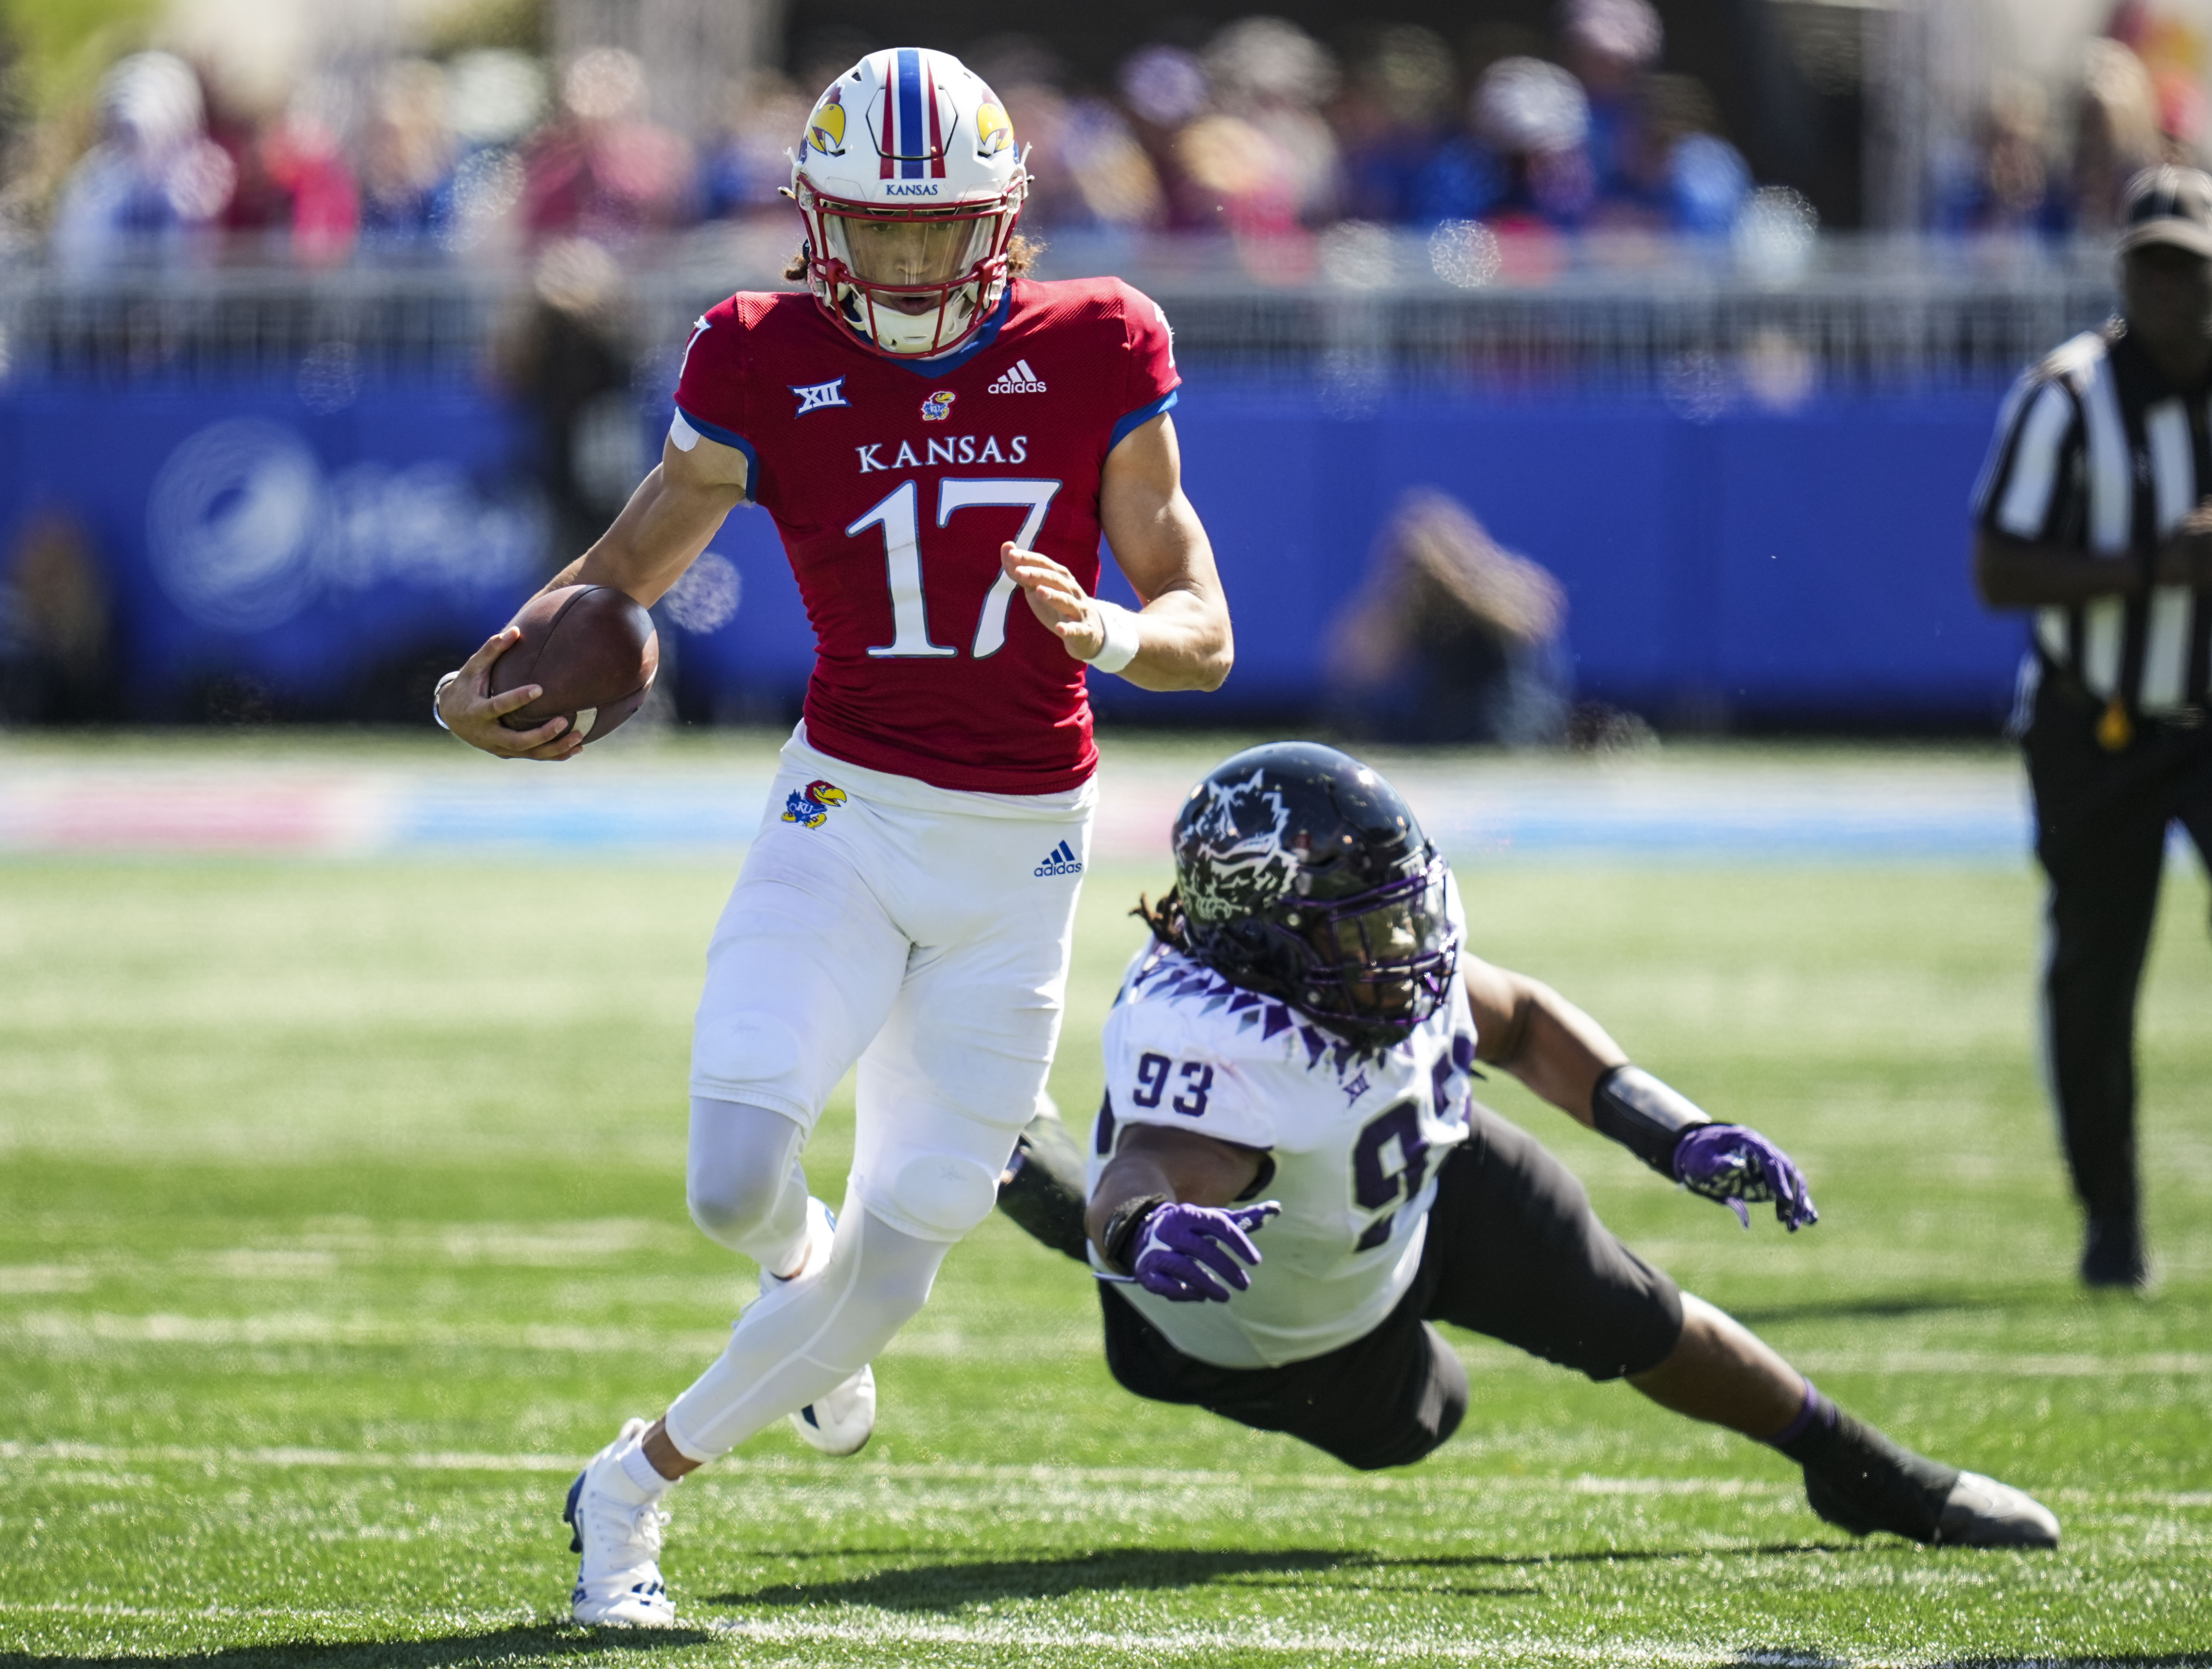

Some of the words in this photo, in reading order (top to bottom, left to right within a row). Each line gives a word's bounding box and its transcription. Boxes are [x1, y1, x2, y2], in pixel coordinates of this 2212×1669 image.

[886, 184, 938, 195] KANSAS
[793, 379, 847, 414] XII
[988, 380, 1047, 394] adidas
[855, 435, 1028, 473] KANSAS
[845, 477, 1063, 660] 17
[1034, 862, 1082, 877] adidas
[1133, 1053, 1214, 1118] 93
